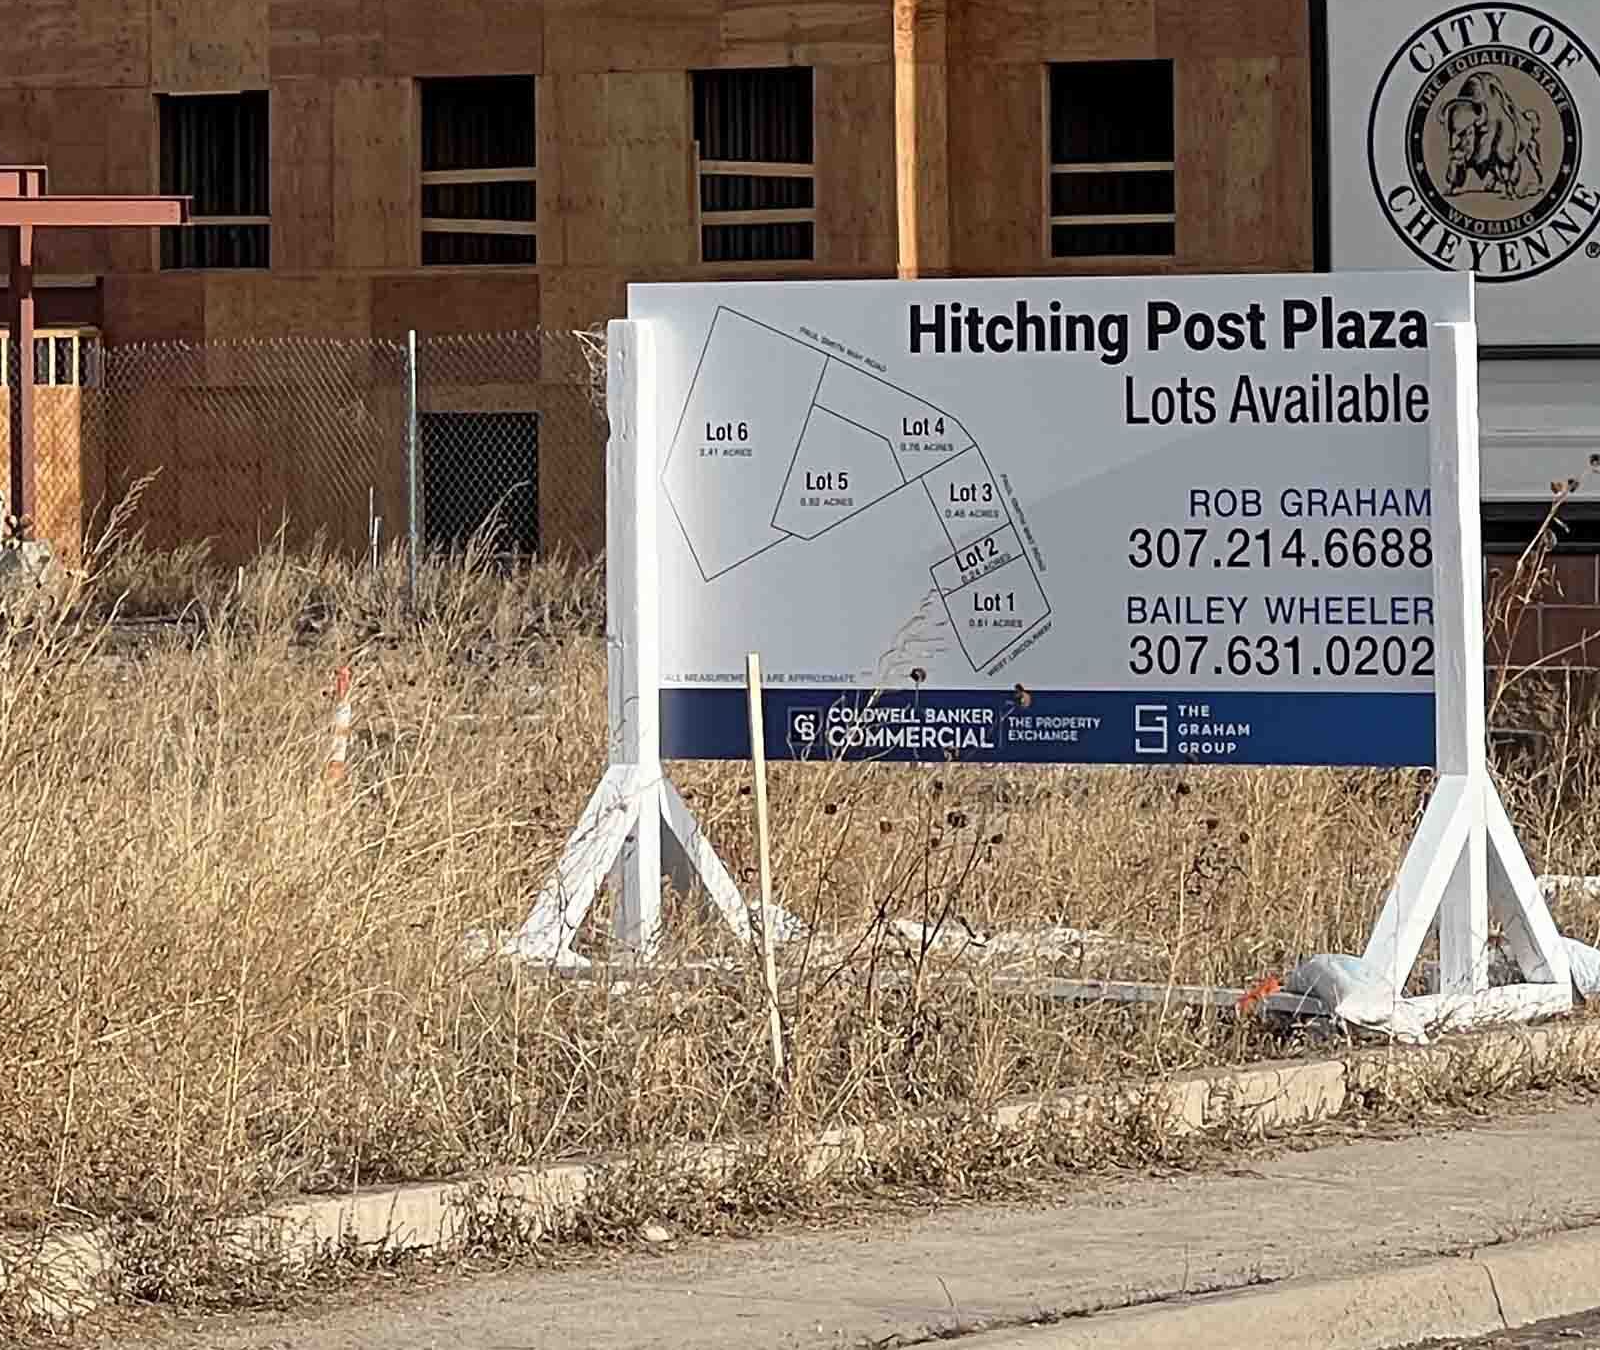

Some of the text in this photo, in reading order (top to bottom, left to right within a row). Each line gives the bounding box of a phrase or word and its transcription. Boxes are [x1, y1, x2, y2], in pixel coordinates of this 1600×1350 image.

[1408, 12, 1584, 74] CITY OF
[1418, 51, 1570, 111] THE EQUALITY STATE
[1448, 208, 1535, 235] WYOMING
[909, 296, 1429, 366] Hitching Post Plaza
[1125, 371, 1431, 425] Lots Available
[706, 422, 749, 441] Lot 6
[903, 417, 945, 436] Lot 4
[805, 471, 849, 491] Lot 5
[950, 483, 993, 502] Lot 3
[1190, 488, 1432, 517] ROB GRAHAM
[968, 509, 1000, 519] ACRES
[955, 537, 1000, 573] Lot 2
[1128, 527, 1433, 569] 307.214.6688
[974, 592, 1015, 612] Lot 1
[1127, 596, 1434, 626] BAILEY WHEELER
[992, 619, 1023, 628] ACRES
[1129, 635, 1434, 676] 307.631.0202
[684, 673, 749, 683] MEASUREME
[765, 673, 786, 683] ARE
[827, 707, 994, 725] COLDWELL BANKER
[1178, 705, 1210, 717] THE
[1007, 716, 1101, 730] THE PROPERTY
[1178, 723, 1251, 736] GRAHAM
[827, 725, 995, 749] COMMERCIAL
[1007, 729, 1079, 742] EXCHANGE
[1178, 741, 1237, 754] GROUP
